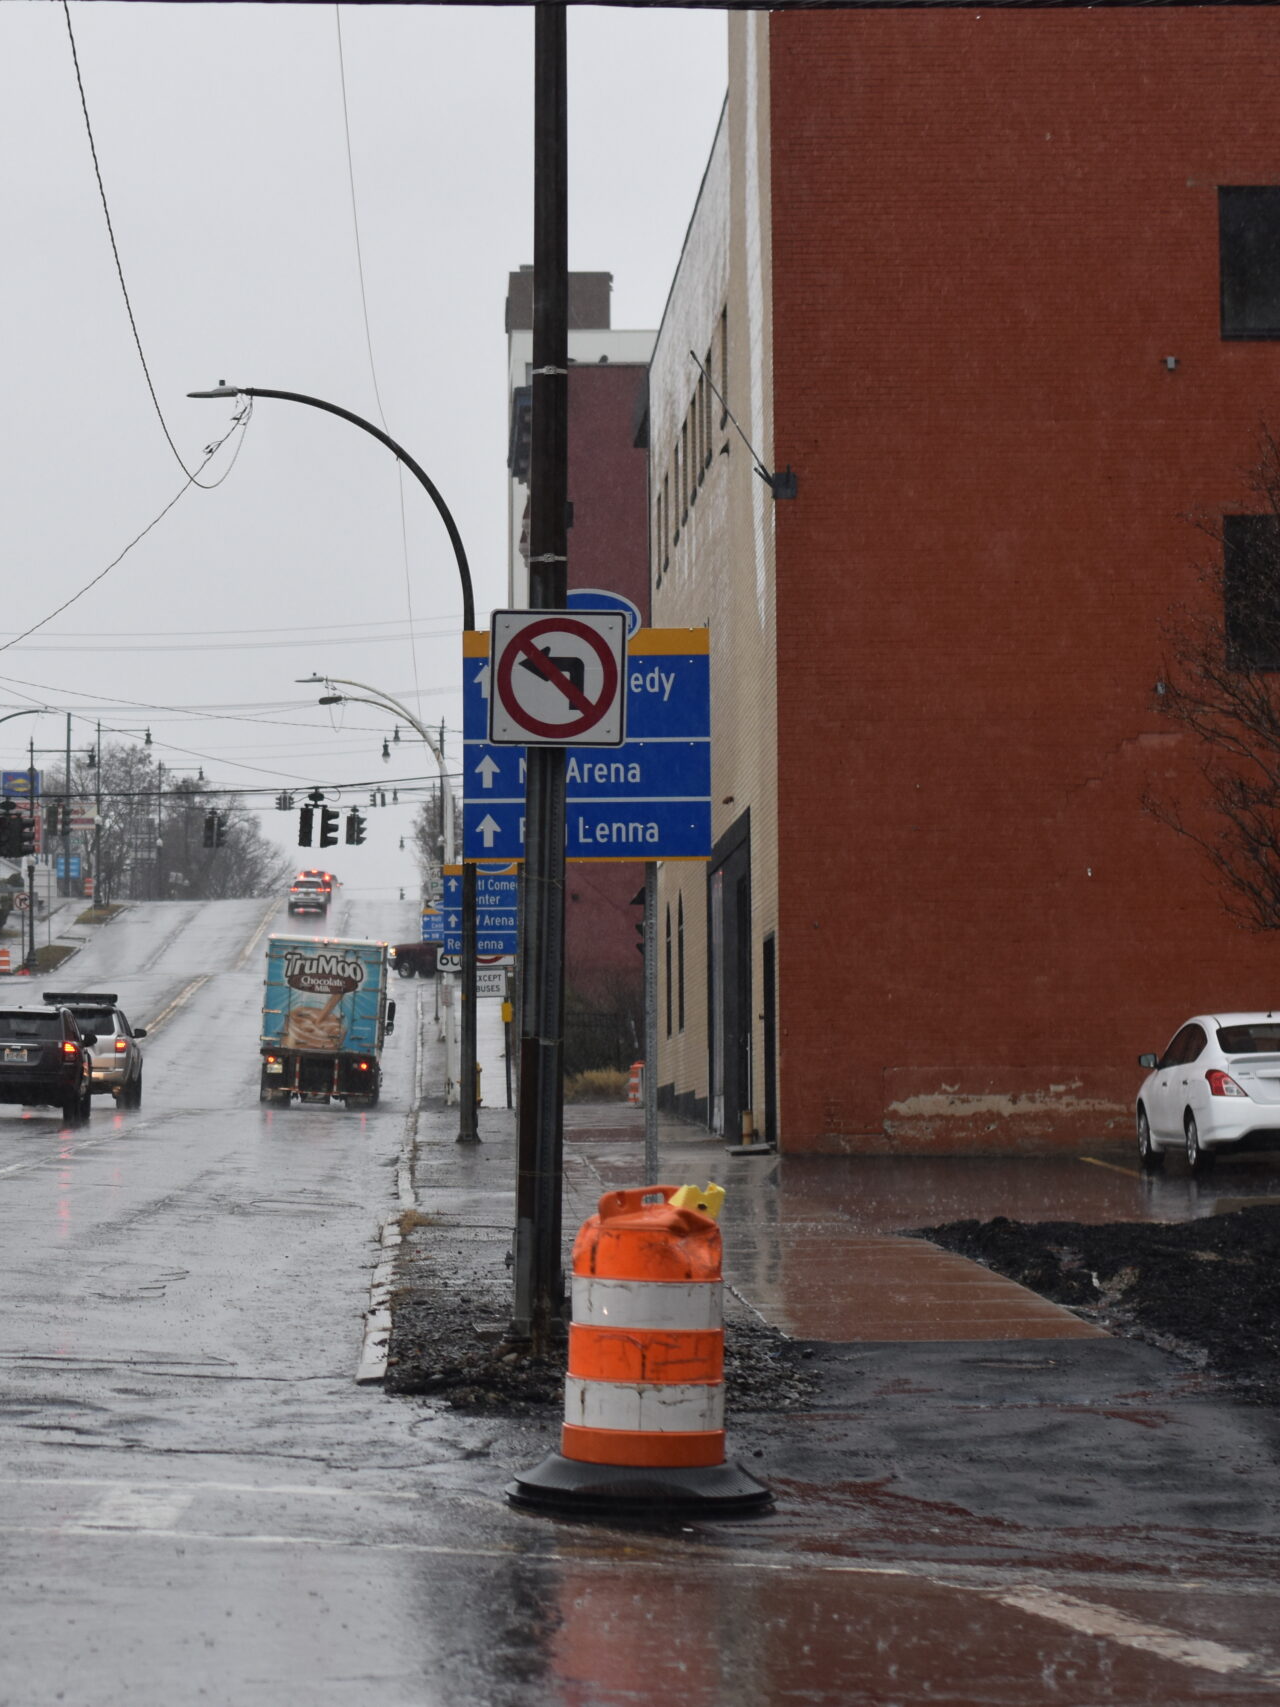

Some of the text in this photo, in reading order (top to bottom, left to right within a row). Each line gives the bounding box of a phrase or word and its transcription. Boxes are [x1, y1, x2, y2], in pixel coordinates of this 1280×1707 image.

[630, 666, 675, 702] edy
[566, 756, 641, 784] Arena
[578, 816, 660, 843] Lenna
[476, 894, 501, 905] nter
[484, 915, 515, 926] Arena
[447, 939, 504, 950] Re enna
[285, 953, 363, 982] TruMoo
[301, 976, 345, 986] Chocolate
[314, 985, 331, 993] Milk
